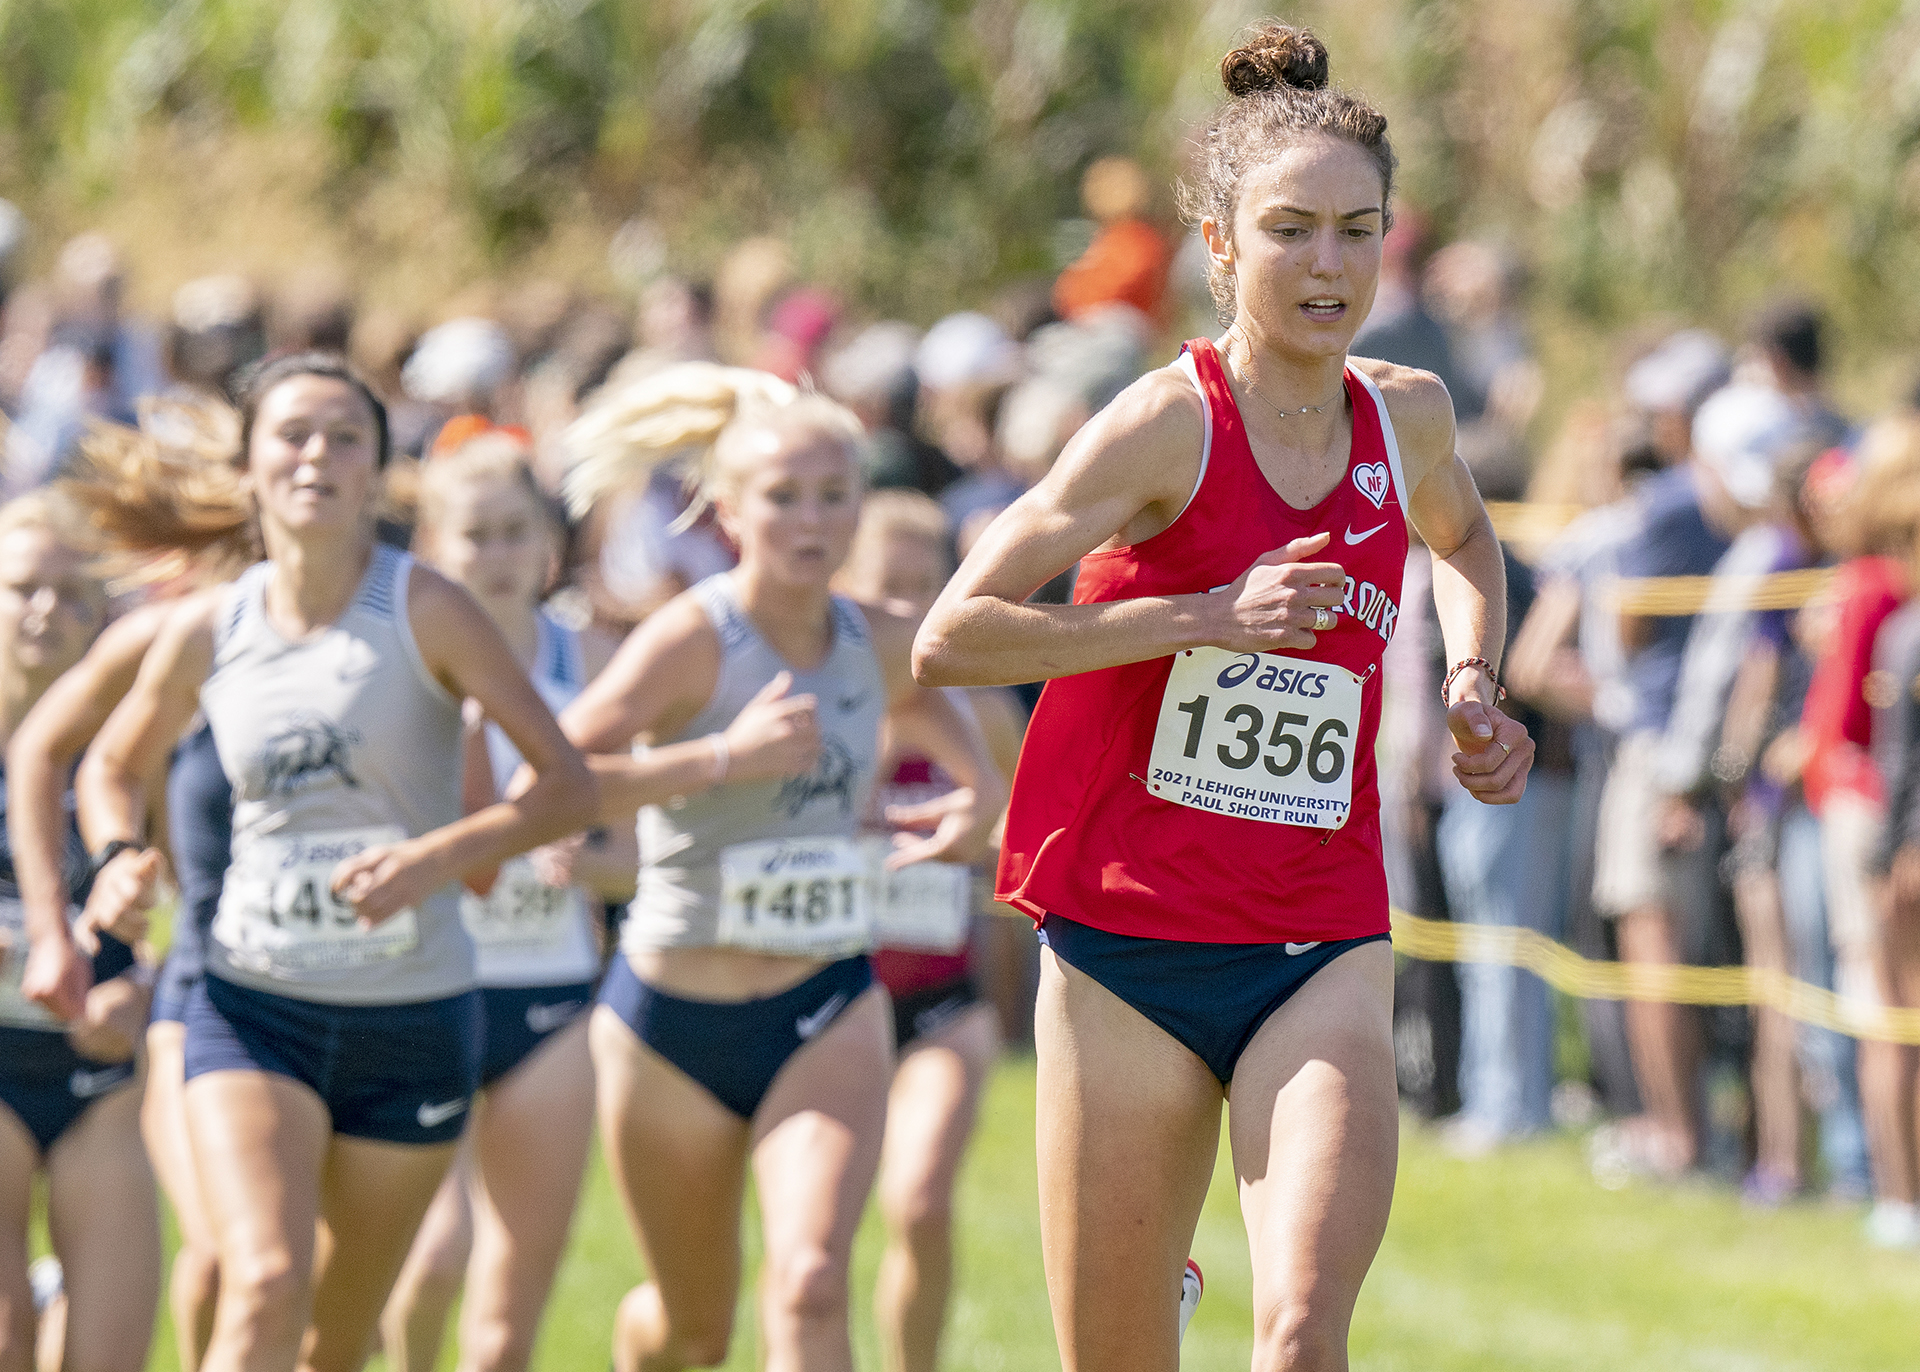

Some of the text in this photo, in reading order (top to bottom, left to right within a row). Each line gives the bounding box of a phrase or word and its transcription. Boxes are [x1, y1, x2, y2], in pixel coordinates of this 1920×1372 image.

[1367, 476, 1382, 492] NF
[1177, 694, 1349, 784] 1356
[1153, 768, 1350, 813] 2021 LEHIGH UNIVERSITY
[1181, 791, 1319, 825] PAUL SHORT RUN
